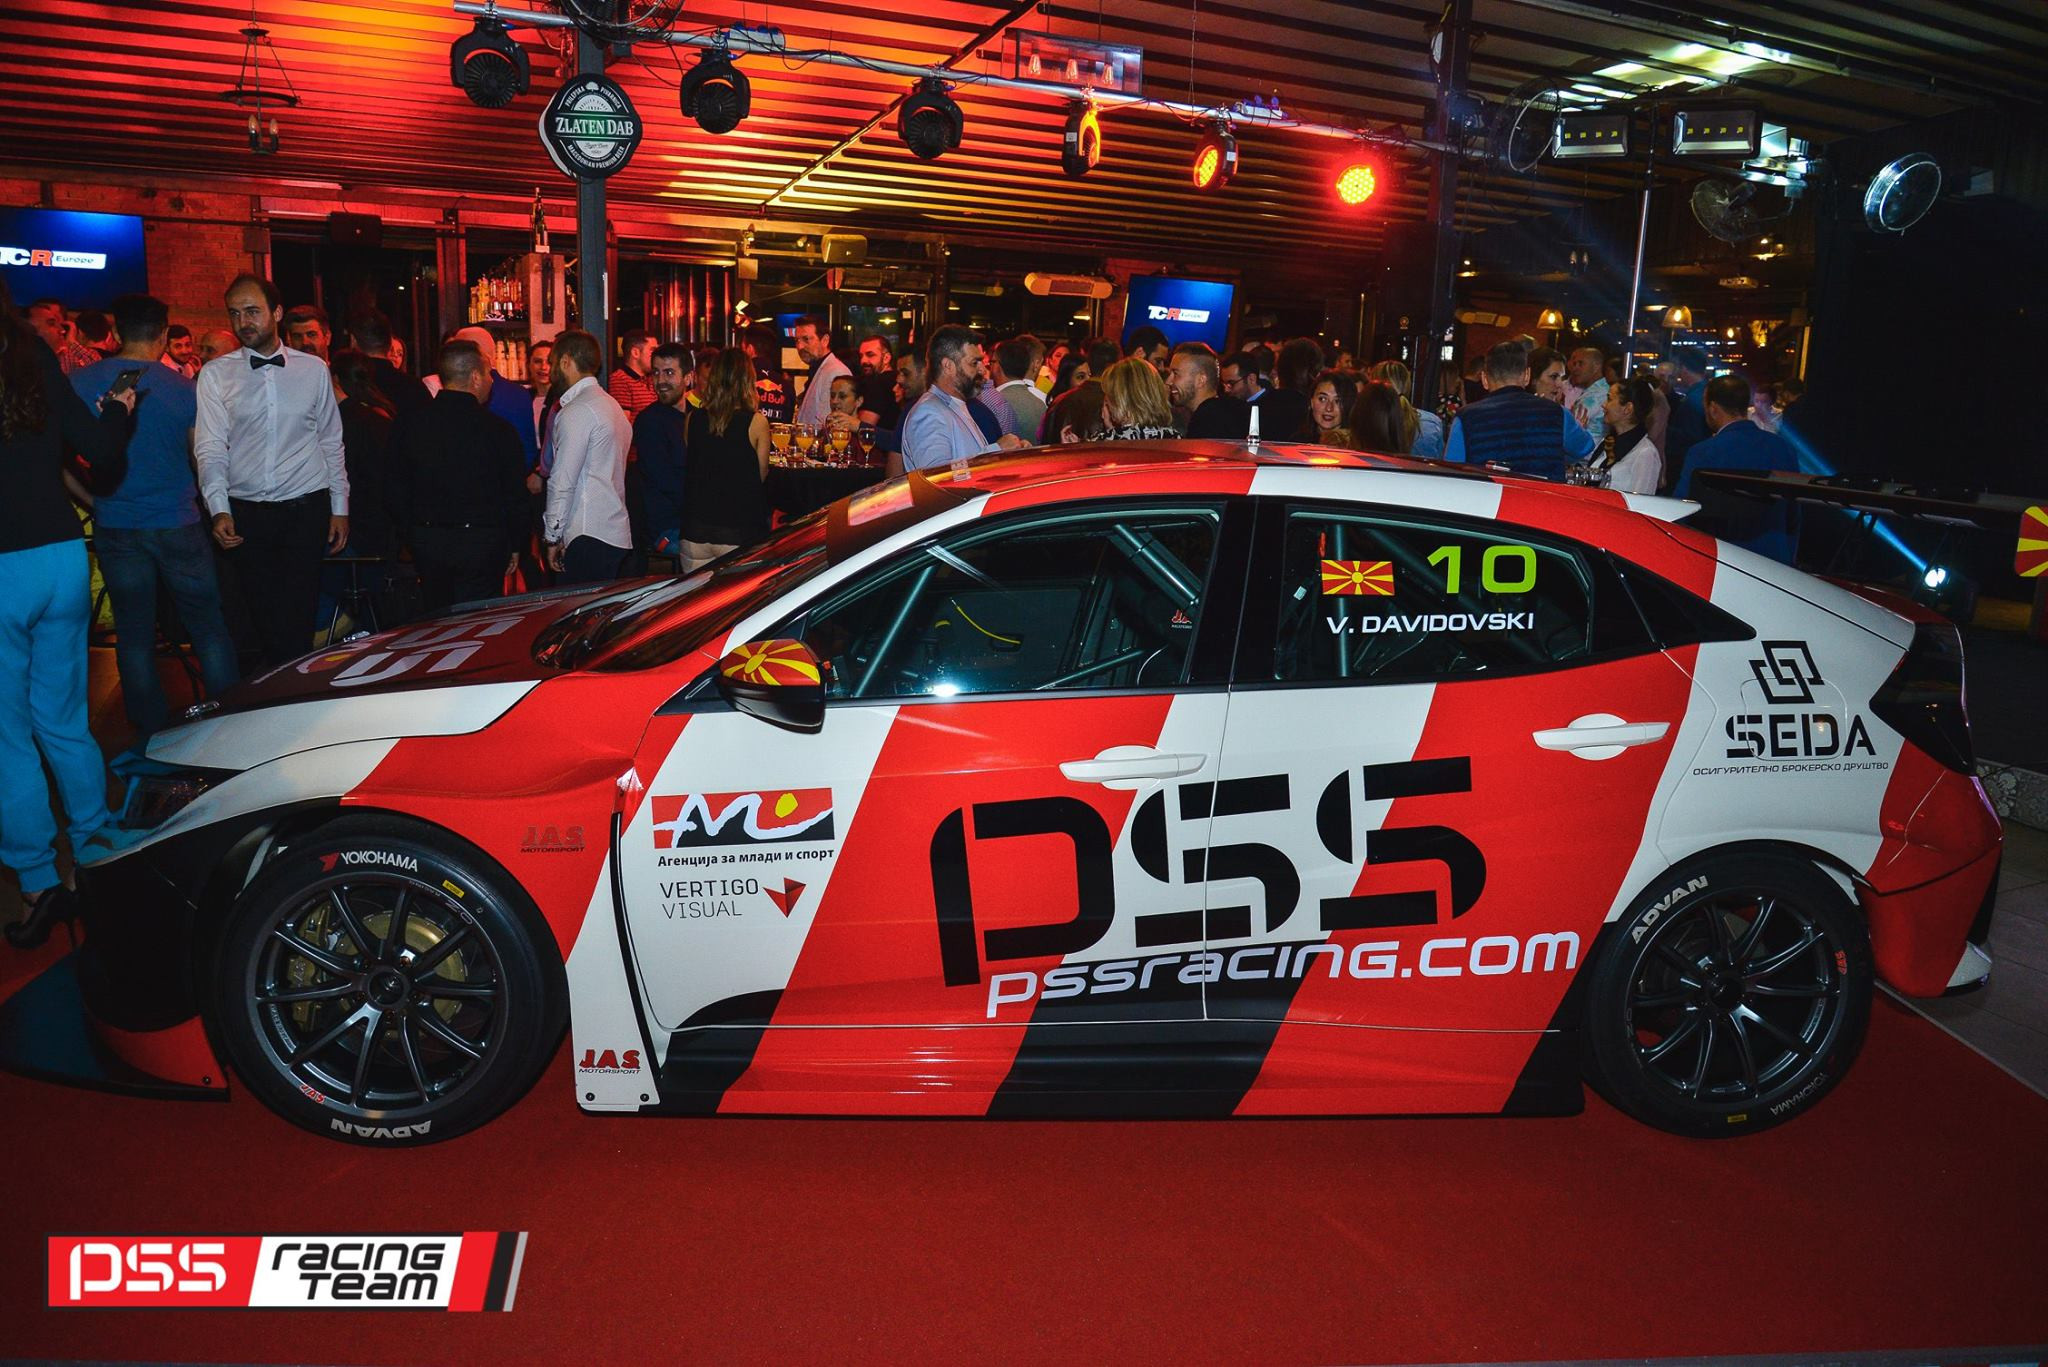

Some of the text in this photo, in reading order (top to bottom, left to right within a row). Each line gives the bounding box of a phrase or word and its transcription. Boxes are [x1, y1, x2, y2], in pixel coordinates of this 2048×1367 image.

[555, 117, 634, 135] ZLATEN DAB
[567, 144, 595, 168] MACEDONIAN
[596, 156, 616, 168] PREMIUM
[0, 246, 94, 267] TCR Europe
[1148, 305, 1181, 320] TCR
[768, 393, 785, 404] Bull
[1427, 545, 1537, 594] 10
[1326, 612, 1535, 634] V. DAVIDOVSKI
[1692, 762, 1889, 776] ОСИГУРИТЕЛНО БРОКЕРСКО ДРУШТВО
[521, 825, 585, 848] JAS
[340, 850, 418, 873] YOKOHAMA
[658, 849, 835, 868] Агенција за млади и спорт
[659, 878, 760, 899] VERTIGO
[662, 900, 743, 920] VISUAL
[1631, 875, 1709, 945] ADVAN
[579, 1049, 640, 1069] JAS
[300, 1084, 327, 1105] JAS
[1769, 1072, 1829, 1116] YOKOHAMA
[331, 1118, 432, 1139] ADVAN
